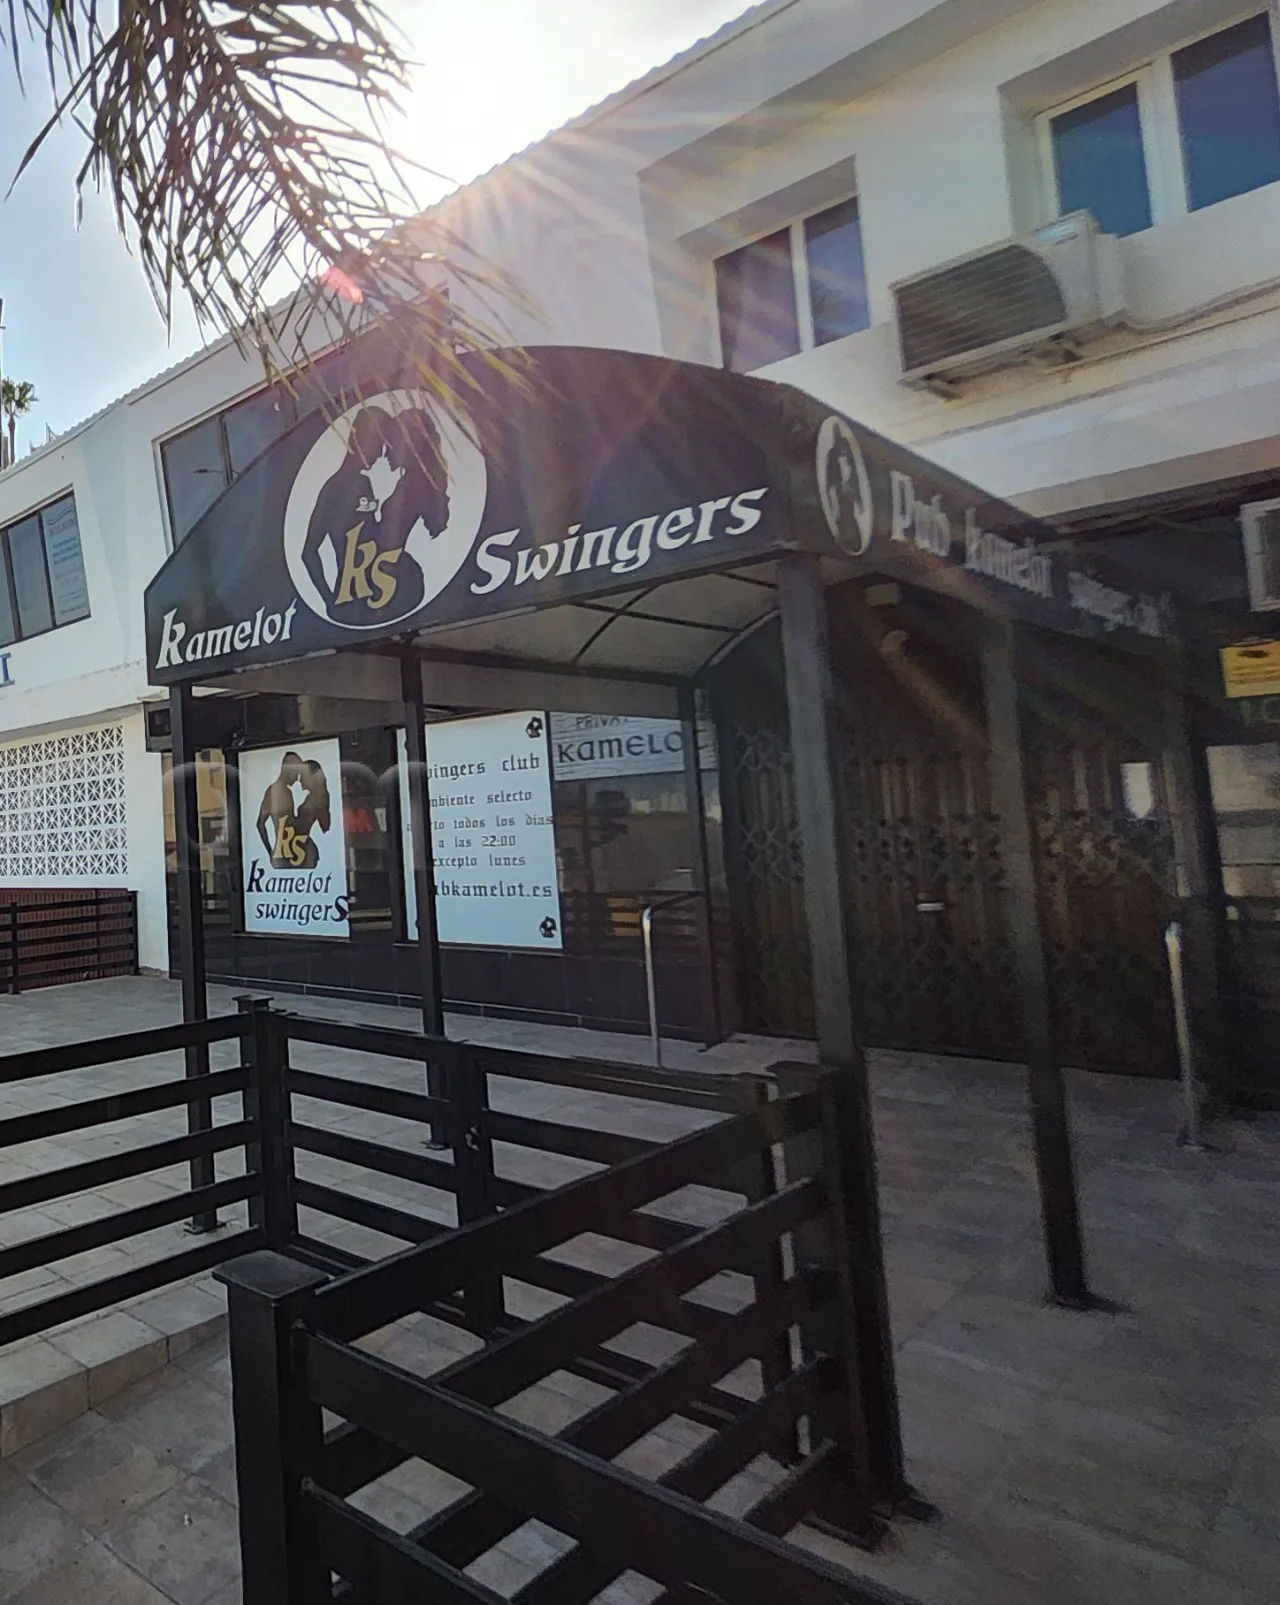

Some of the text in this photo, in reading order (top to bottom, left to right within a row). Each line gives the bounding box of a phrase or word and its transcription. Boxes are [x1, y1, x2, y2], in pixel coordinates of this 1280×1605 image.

[469, 486, 770, 595] Swingers
[502, 752, 540, 772] club
[486, 789, 532, 804] selecto
[454, 816, 486, 830] todos
[496, 815, 516, 828] los
[438, 839, 445, 848] a
[454, 836, 472, 849] las
[489, 854, 527, 867] lunes
